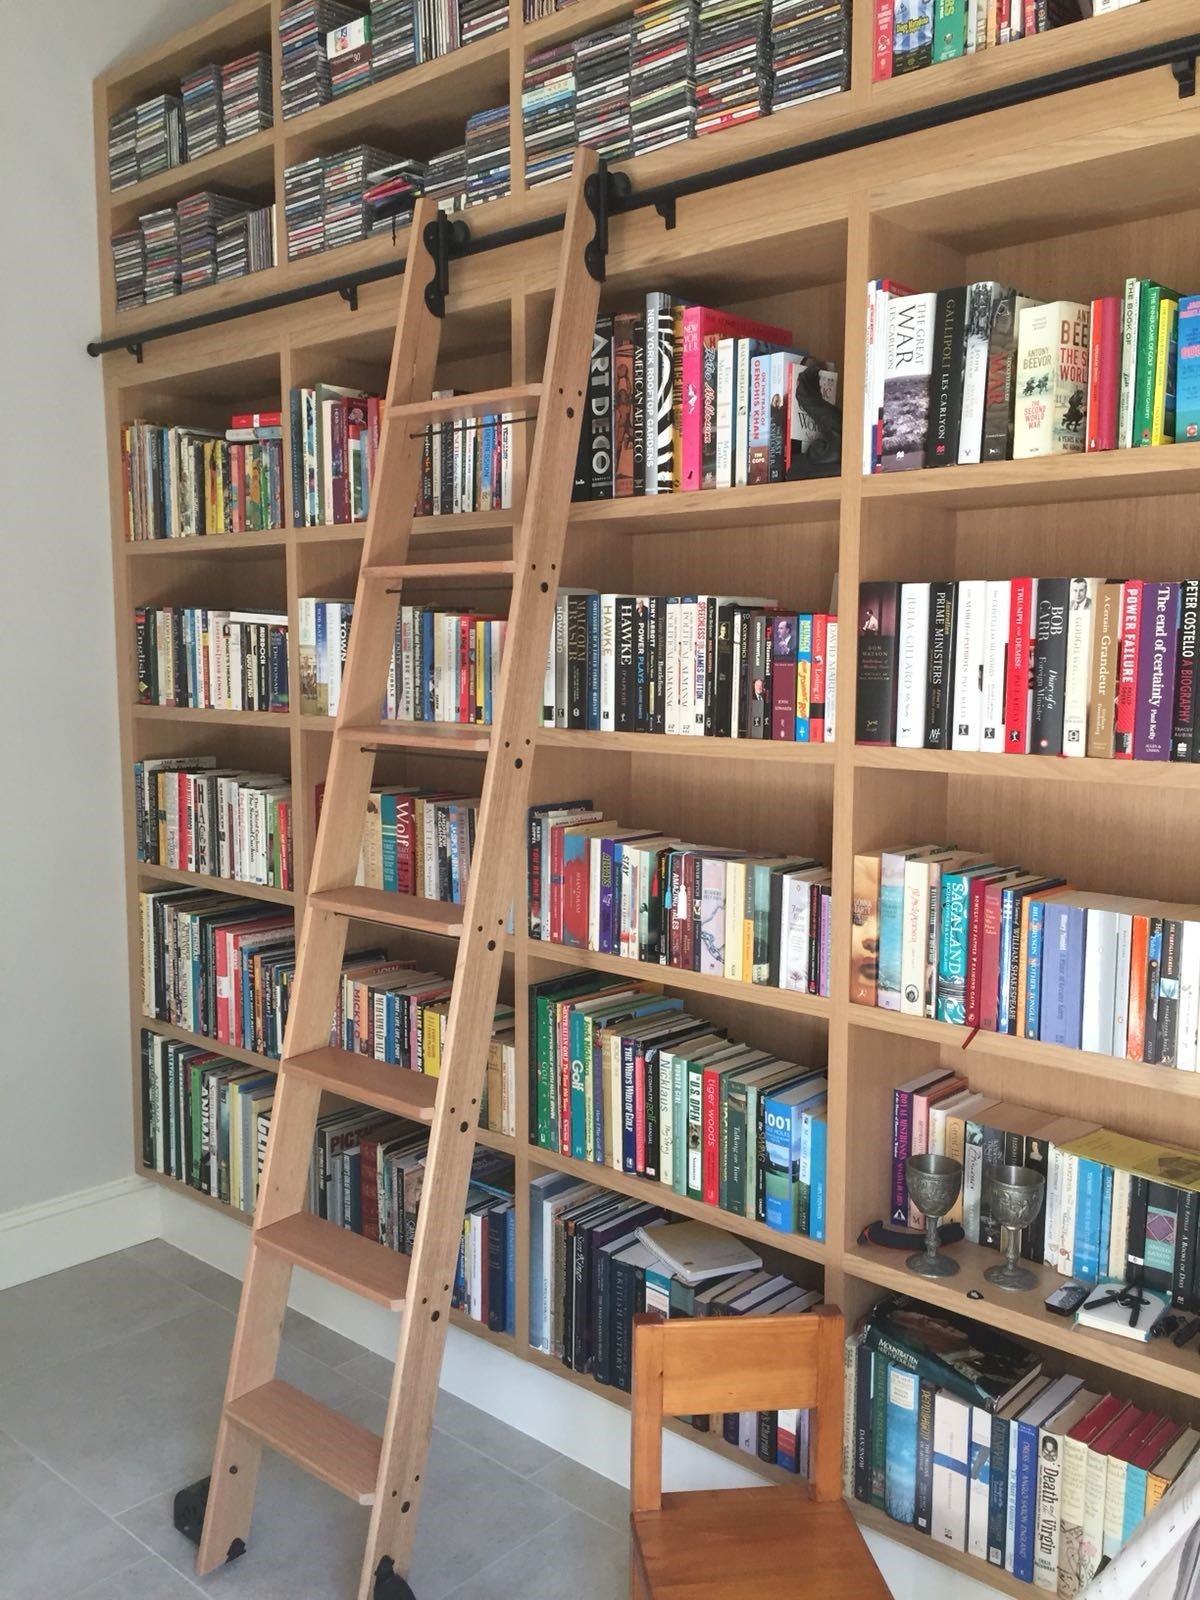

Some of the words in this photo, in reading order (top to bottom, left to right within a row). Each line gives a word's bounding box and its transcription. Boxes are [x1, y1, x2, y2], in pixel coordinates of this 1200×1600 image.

[1127, 280, 1135, 299] THE
[647, 309, 655, 332] NEW
[917, 303, 926, 324] THE
[1126, 305, 1134, 332] BOOK
[647, 336, 655, 364] YORK
[895, 304, 917, 369] WAR
[914, 326, 926, 366] GREAT
[942, 299, 955, 368] GALLIPOLI
[1060, 319, 1089, 348] BEE
[1125, 334, 1132, 345] OF
[591, 332, 609, 387] ART
[1023, 356, 1052, 370] BEEVOR
[1060, 347, 1081, 366] THE
[634, 345, 644, 404] AMERICAN
[646, 367, 654, 415] ROOFTOP
[753, 360, 761, 406] GENGHIS
[941, 372, 950, 391] LES
[987, 351, 1007, 409] WAR
[1060, 365, 1089, 384] WORL
[634, 407, 644, 427] ART
[937, 393, 949, 439] CARLYON
[1024, 406, 1046, 416] SECOND
[591, 396, 611, 475] DECO
[634, 430, 644, 463] DECO
[646, 418, 654, 467] GARDENS
[936, 592, 946, 625] PRIME
[1125, 588, 1139, 629] POWER
[1157, 587, 1171, 611] The
[1184, 580, 1199, 608] PETER
[697, 601, 707, 640] SPEECHLESS
[906, 597, 917, 629] JULIA
[1038, 600, 1051, 641] CARR
[1050, 606, 1064, 635] BOB
[1156, 614, 1167, 636] end
[603, 605, 613, 657] HAWKE
[620, 605, 632, 666] HAWKE
[637, 622, 645, 654] POWER
[829, 624, 837, 658] DAVID
[1155, 639, 1167, 653] of
[1182, 611, 1197, 658] COSTELLO
[136, 624, 147, 679] English
[696, 650, 705, 673] JAMES
[904, 634, 914, 689] GILLARD
[932, 628, 944, 685] MINISTERS
[1098, 635, 1112, 696] Grandeur
[1121, 633, 1137, 683] FAILURE
[637, 656, 645, 684] PLAYS
[827, 659, 835, 694] MARR
[1036, 656, 1047, 687] Foreign
[1148, 653, 1165, 707] certainty
[695, 674, 704, 700] BUTTON
[1179, 669, 1193, 724] BIOGRAPHY
[1035, 689, 1045, 721] Minister
[395, 802, 409, 847] Wolf
[425, 804, 434, 863] MYTHOS
[622, 854, 630, 877] STAY
[1031, 925, 1039, 955] BRYSON
[1029, 959, 1038, 990] MOTHER
[1009, 964, 1018, 1020] SHAKESPEARE
[624, 1047, 634, 1062] THE
[571, 1059, 585, 1093] Golf
[660, 1059, 673, 1112] Nicklaus
[706, 1078, 717, 1106] tiger
[624, 1085, 634, 1102] WHO
[624, 1102, 634, 1113] OF
[688, 1097, 700, 1123] OPEN
[624, 1112, 634, 1132] GOLF
[707, 1109, 715, 1147] woods
[764, 1111, 792, 1131] 1001
[613, 1321, 623, 1371] HISTORY
[878, 1338, 919, 1366] MOUNTBATTEN
[1042, 1465, 1060, 1506] Death
[1039, 1516, 1058, 1556] Virgin
